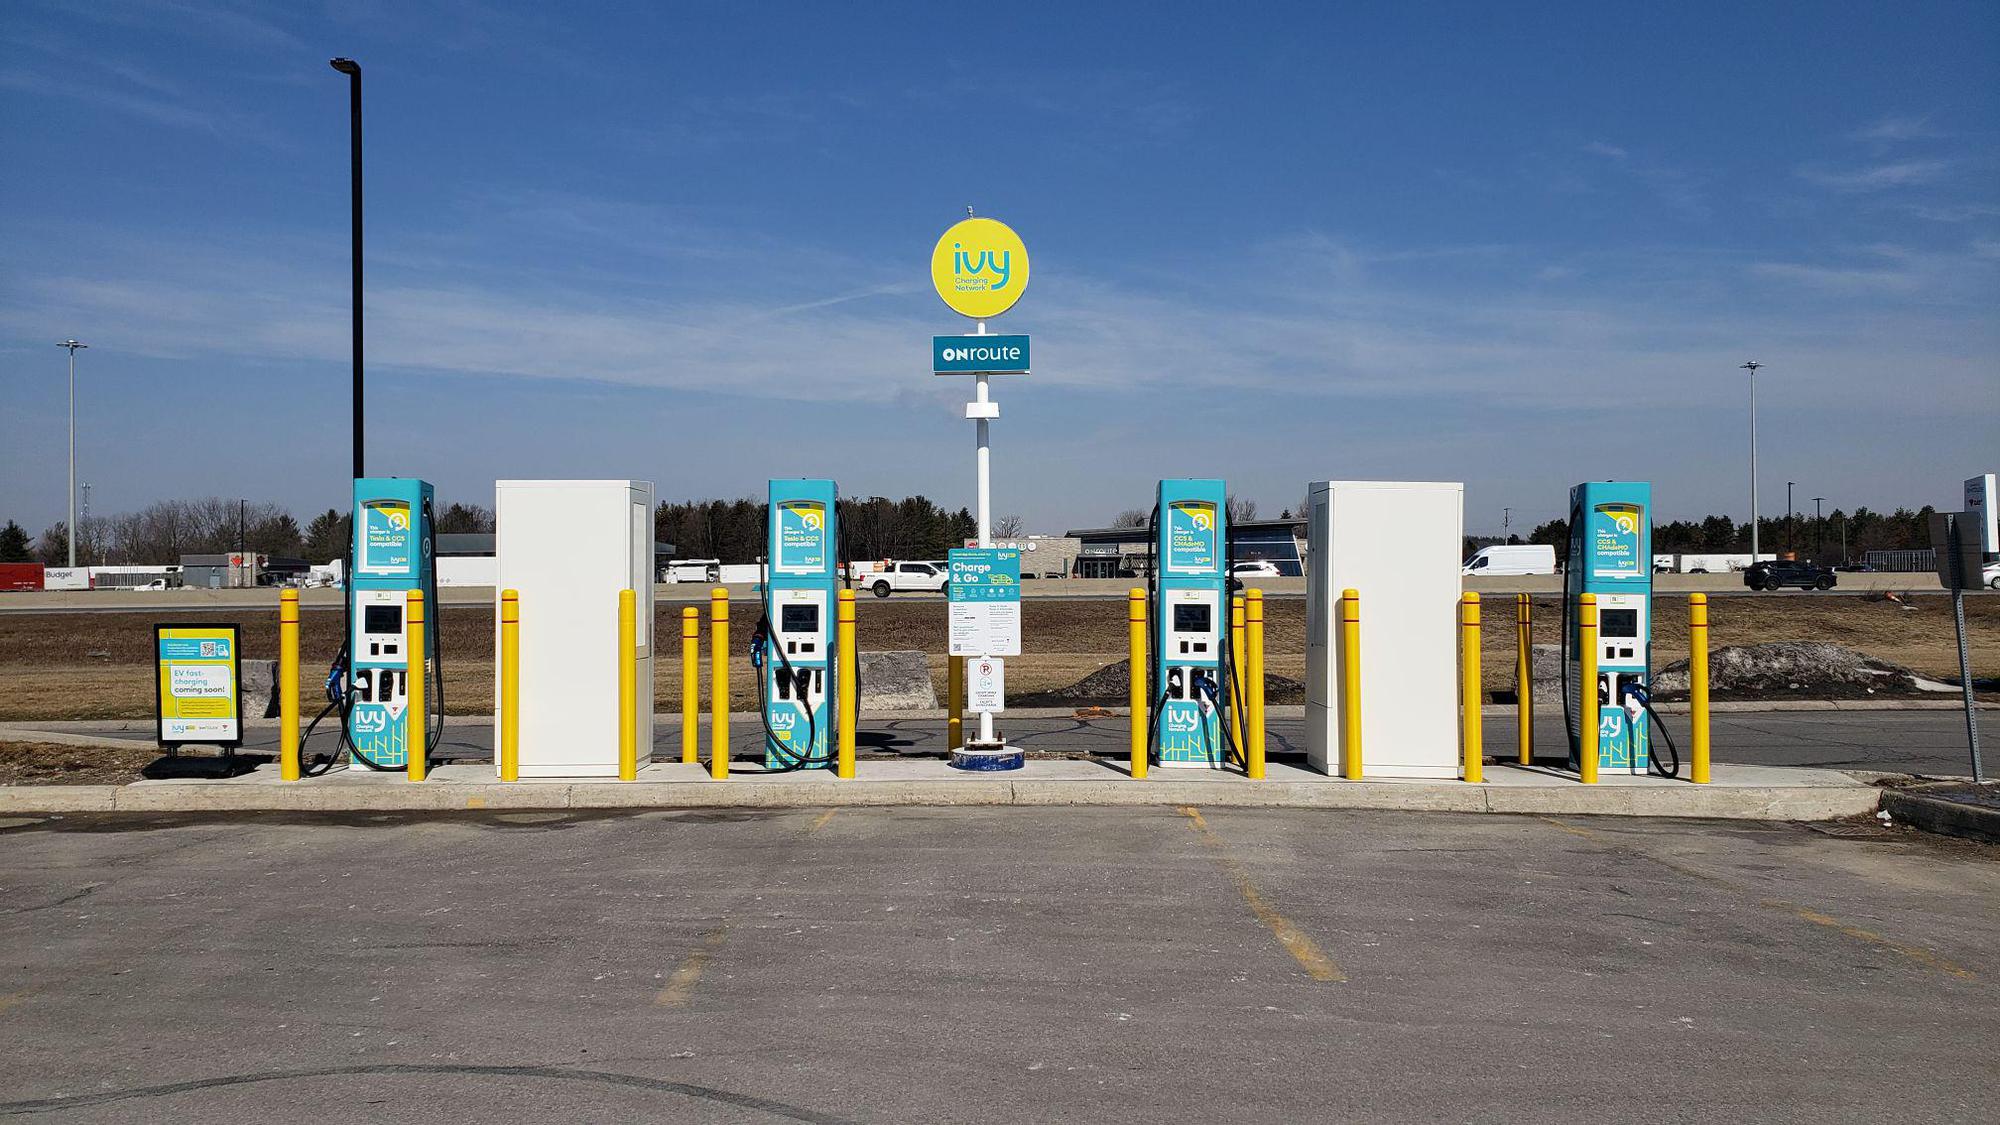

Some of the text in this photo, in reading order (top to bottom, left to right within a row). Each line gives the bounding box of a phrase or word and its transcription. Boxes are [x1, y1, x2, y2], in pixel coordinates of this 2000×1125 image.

[954, 242, 1010, 291] ivy
[954, 277, 989, 286] Charging
[954, 284, 987, 292] Network
[952, 562, 991, 573] Charge
[46, 571, 73, 580] Budget
[952, 573, 979, 583] & Go
[174, 678, 208, 686] charging
[174, 686, 203, 694] coming
[355, 706, 386, 733] ivy
[771, 709, 796, 730] ivy
[1167, 705, 1198, 732] ivy
